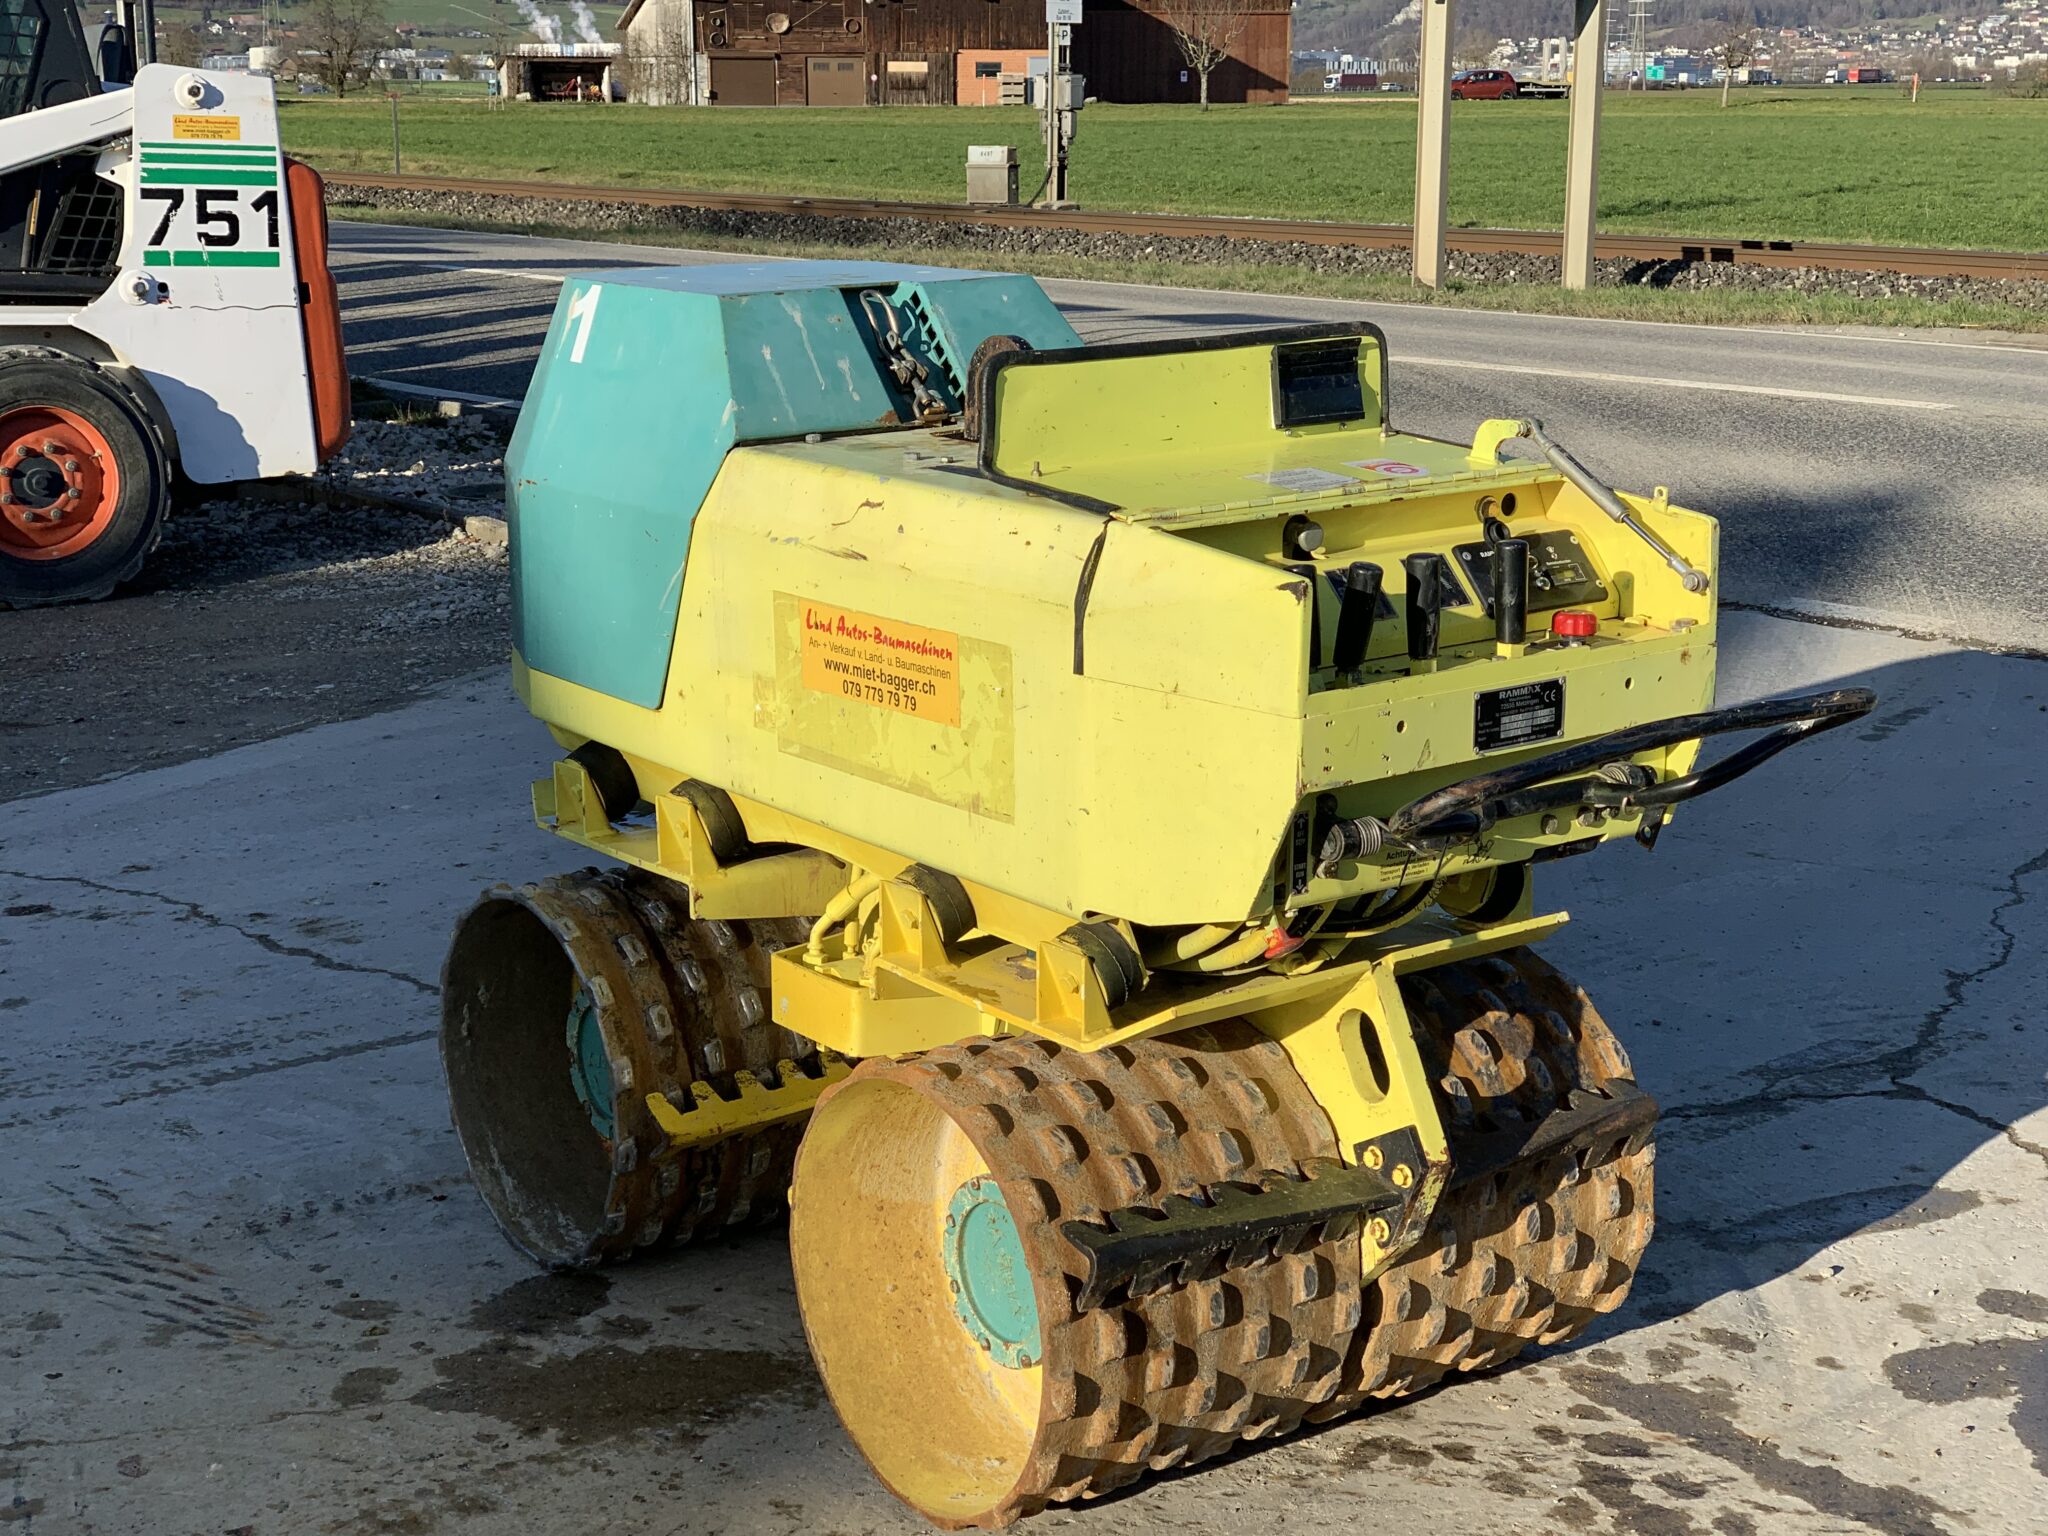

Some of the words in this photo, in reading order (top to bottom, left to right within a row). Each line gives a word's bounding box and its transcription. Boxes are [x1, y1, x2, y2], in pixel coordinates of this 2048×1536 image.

[140, 188, 280, 248] 751
[569, 284, 602, 363] 1
[808, 636, 821, 648] An-
[828, 640, 857, 658] Verkauf
[857, 649, 864, 660] v.
[864, 649, 886, 664] Land-
[895, 656, 952, 680] Baumaschinen
[836, 615, 953, 661] Autos-Baumaschinen
[824, 658, 936, 696] www.miet-bagger.ch
[842, 679, 861, 698] 079
[864, 685, 884, 703] 779
[887, 690, 900, 707] 79
[903, 694, 917, 712] 79
[1499, 685, 1541, 700] RAMMAX
